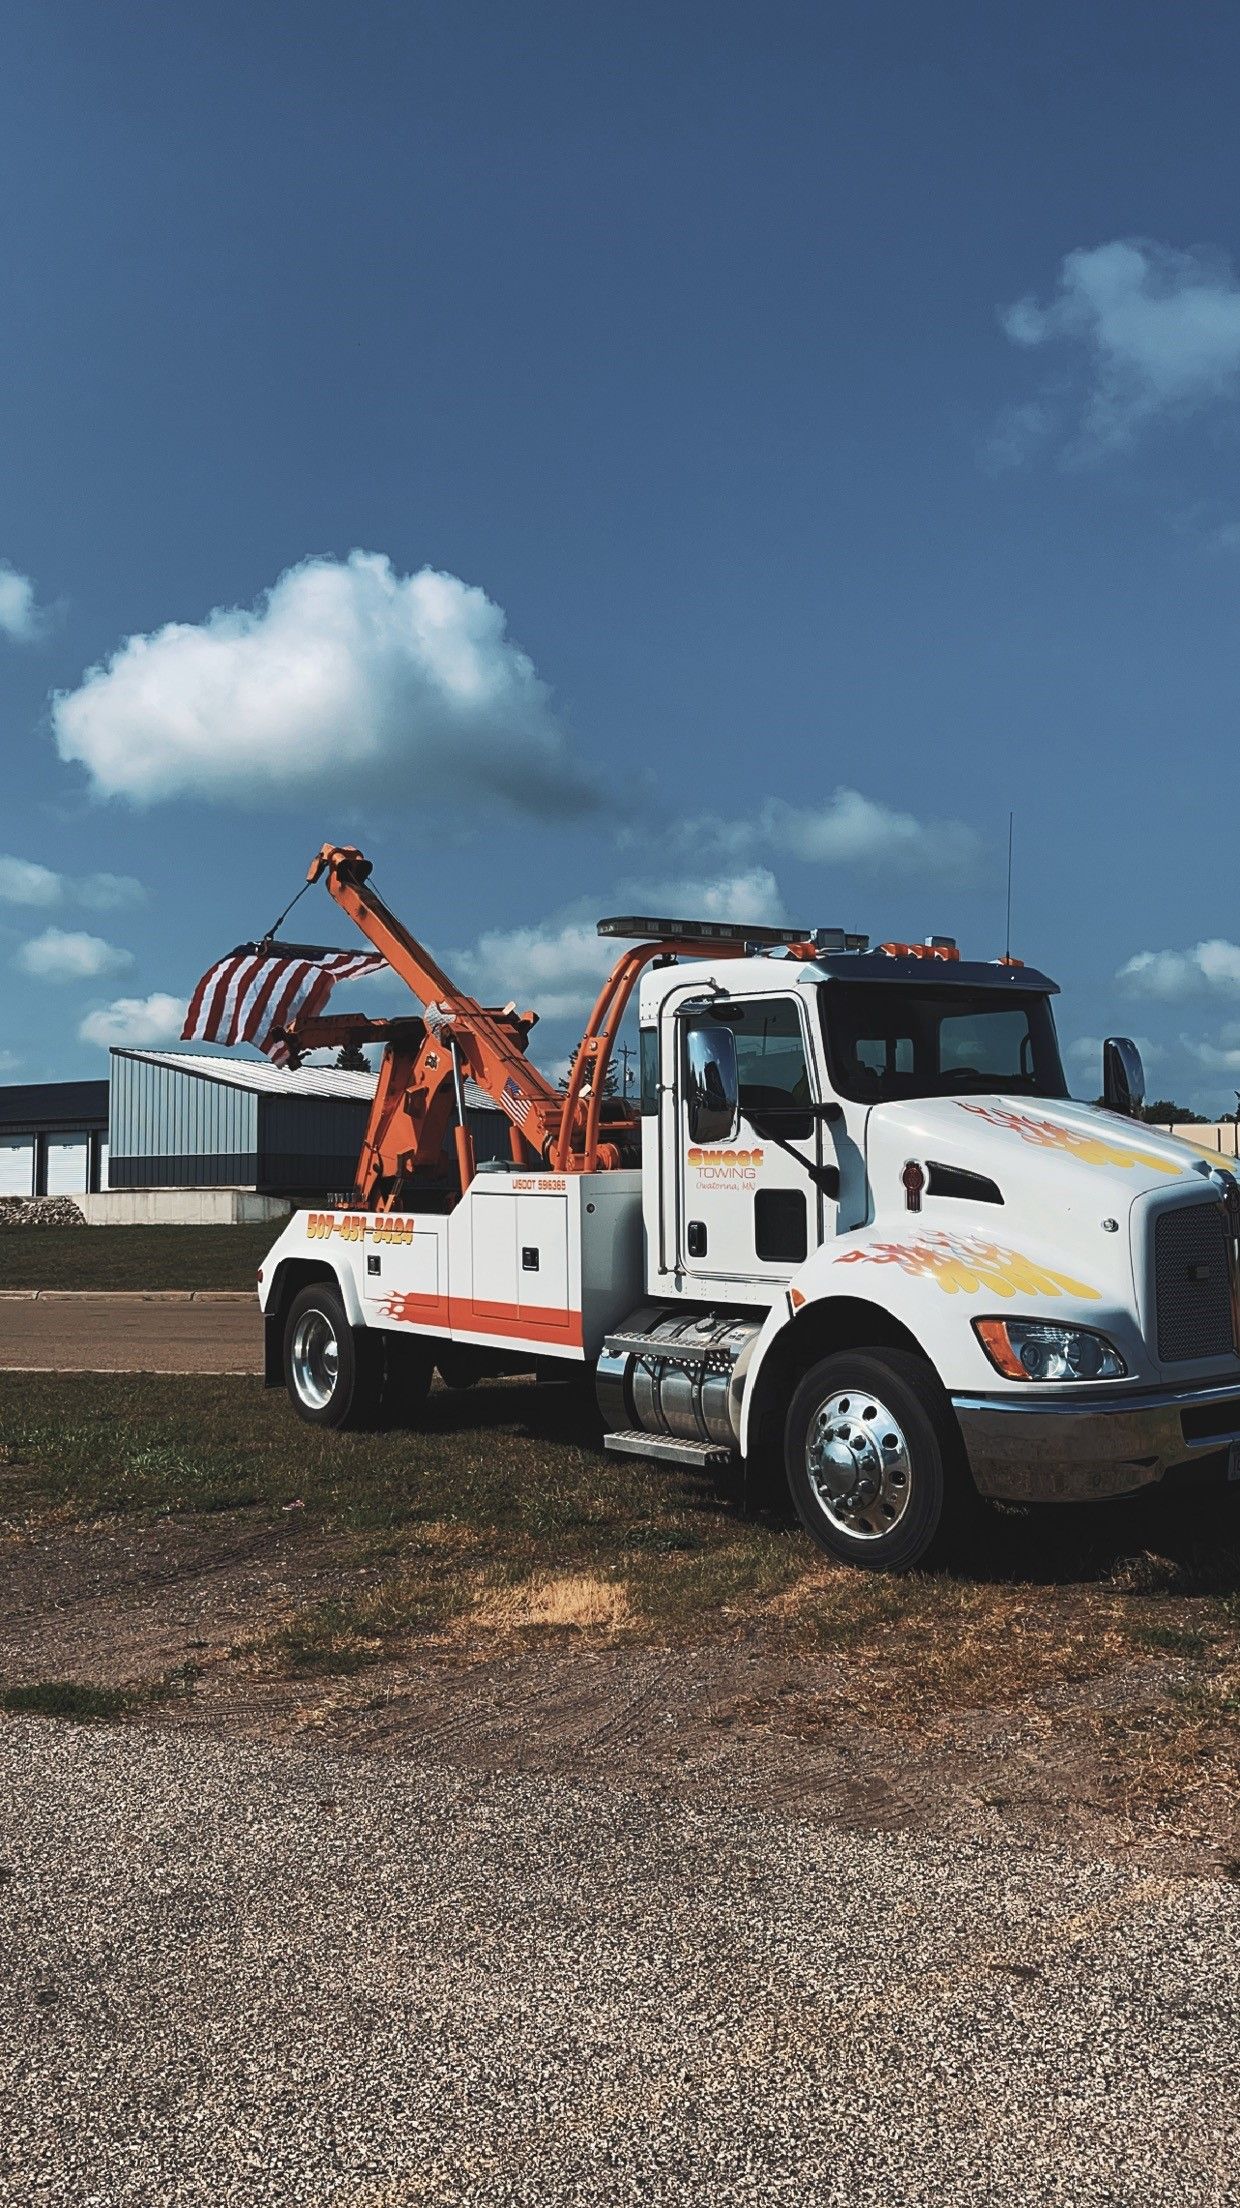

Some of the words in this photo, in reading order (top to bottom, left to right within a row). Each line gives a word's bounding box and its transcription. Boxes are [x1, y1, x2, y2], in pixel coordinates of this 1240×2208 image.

[687, 1147, 764, 1167] Sweet
[696, 1167, 756, 1179] TOWING
[512, 1179, 536, 1190] USDOT
[741, 1182, 756, 1191] MN
[306, 1213, 415, 1246] 507-451-3424
